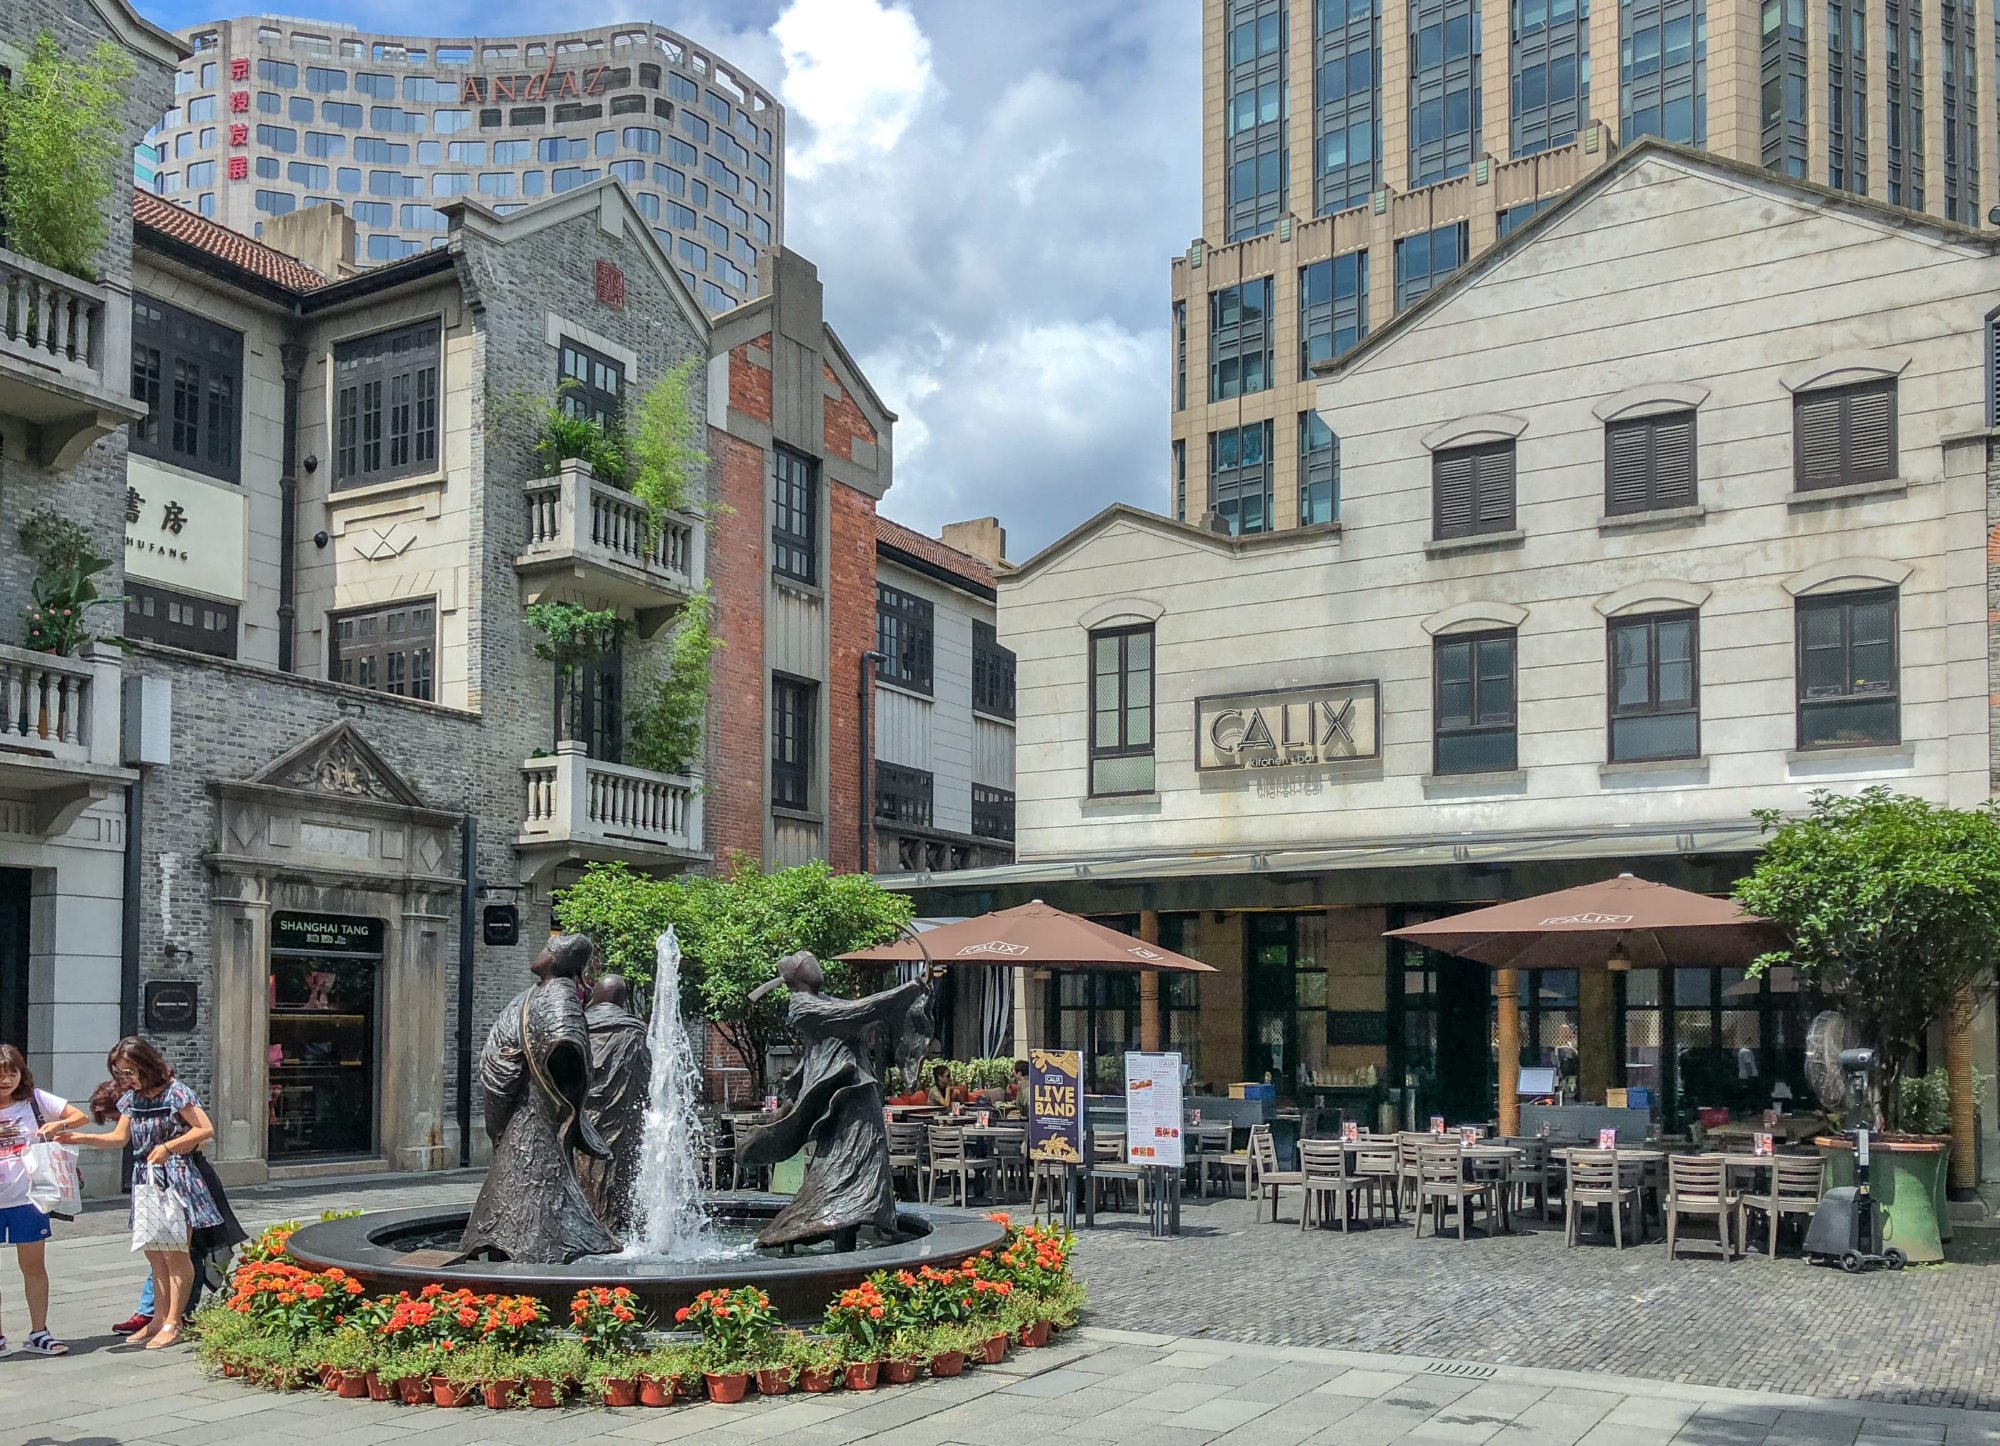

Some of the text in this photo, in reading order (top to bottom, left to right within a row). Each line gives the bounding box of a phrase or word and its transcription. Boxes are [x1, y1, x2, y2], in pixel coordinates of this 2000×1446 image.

[228, 58, 249, 181] 京投发展
[1210, 698, 1354, 755] CALIX
[1248, 753, 1316, 767] kitchen bar
[280, 920, 369, 935] SHANGHAI TANG
[965, 941, 1020, 954] CALIX
[1034, 1085, 1075, 1103] LIVE
[1034, 1101, 1076, 1117] BAND
